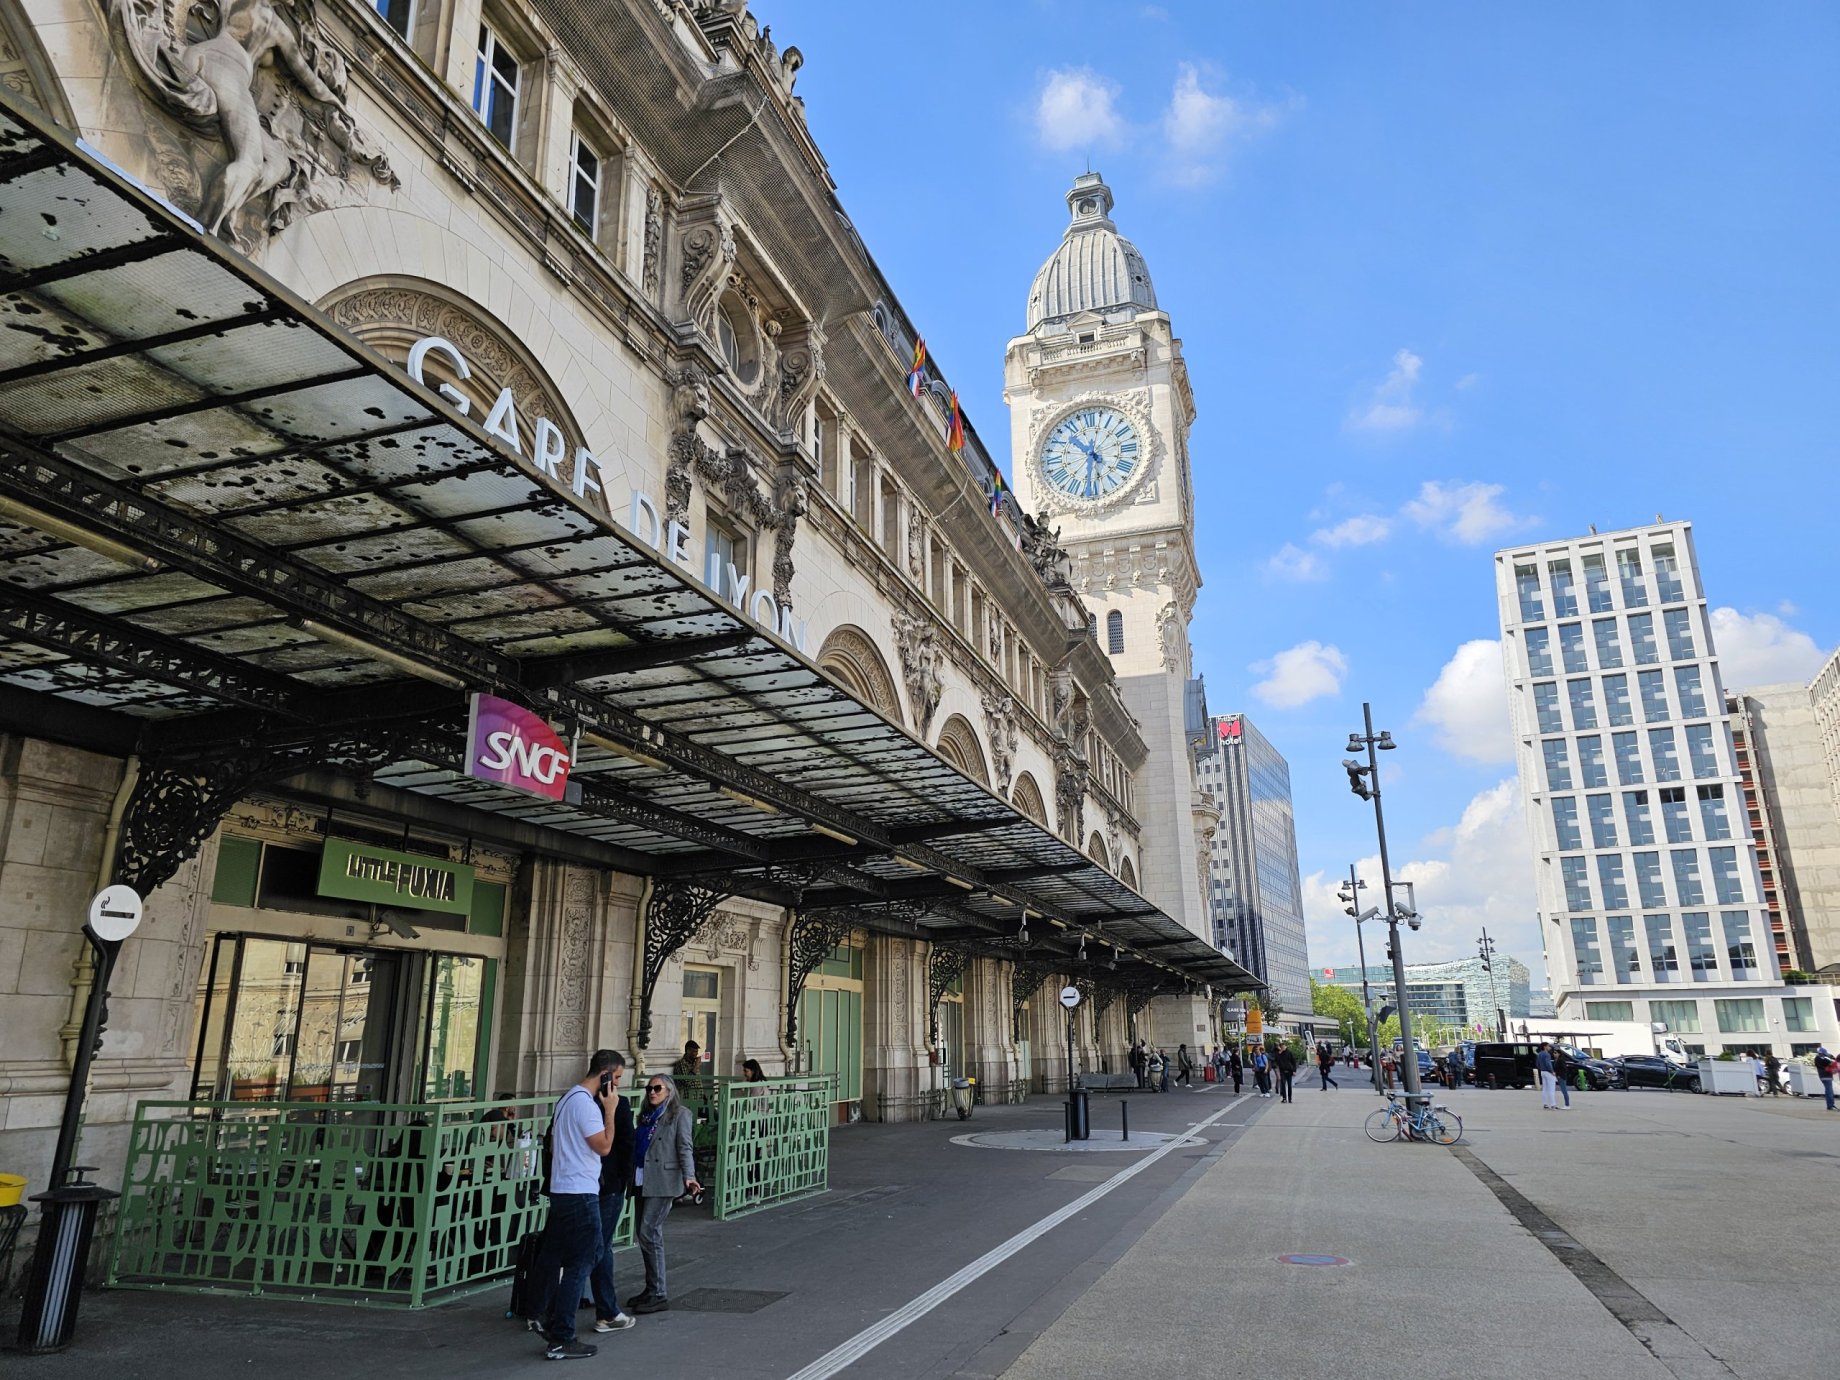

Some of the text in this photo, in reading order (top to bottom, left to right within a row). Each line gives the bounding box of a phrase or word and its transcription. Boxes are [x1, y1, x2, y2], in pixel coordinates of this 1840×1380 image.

[408, 337, 600, 498] GARE
[629, 489, 690, 564] DE
[480, 730, 570, 785] SNCF
[1220, 736, 1242, 745] hotel
[346, 853, 457, 902] LITTLE FUXIA
